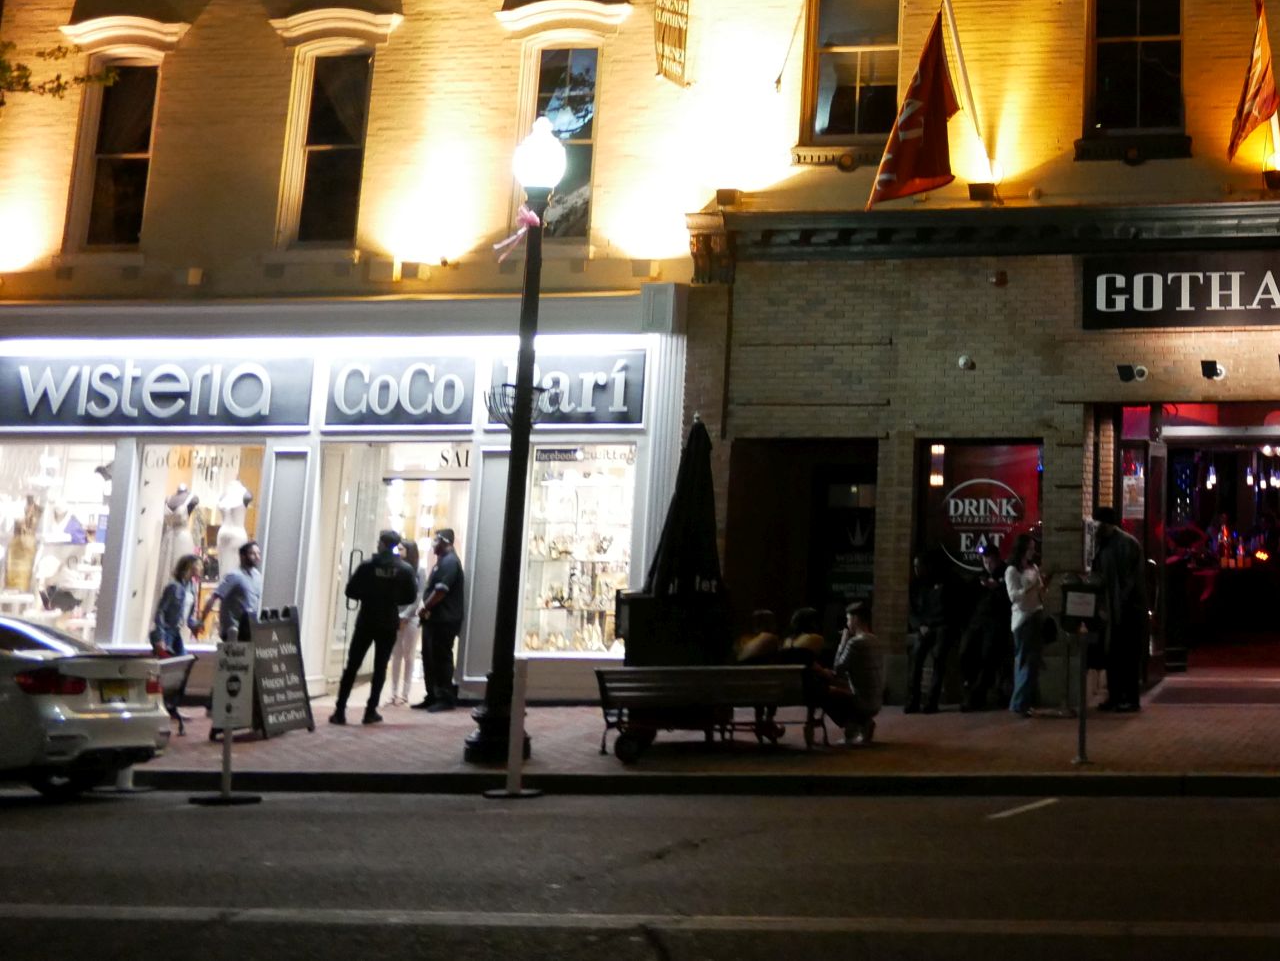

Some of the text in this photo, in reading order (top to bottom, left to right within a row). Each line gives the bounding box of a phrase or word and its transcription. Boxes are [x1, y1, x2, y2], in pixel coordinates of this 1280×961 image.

[19, 359, 271, 418] wisteria
[333, 362, 464, 415] CoCo
[949, 498, 1018, 517] DRINK
[960, 532, 1006, 553] EAT
[271, 631, 279, 641] A
